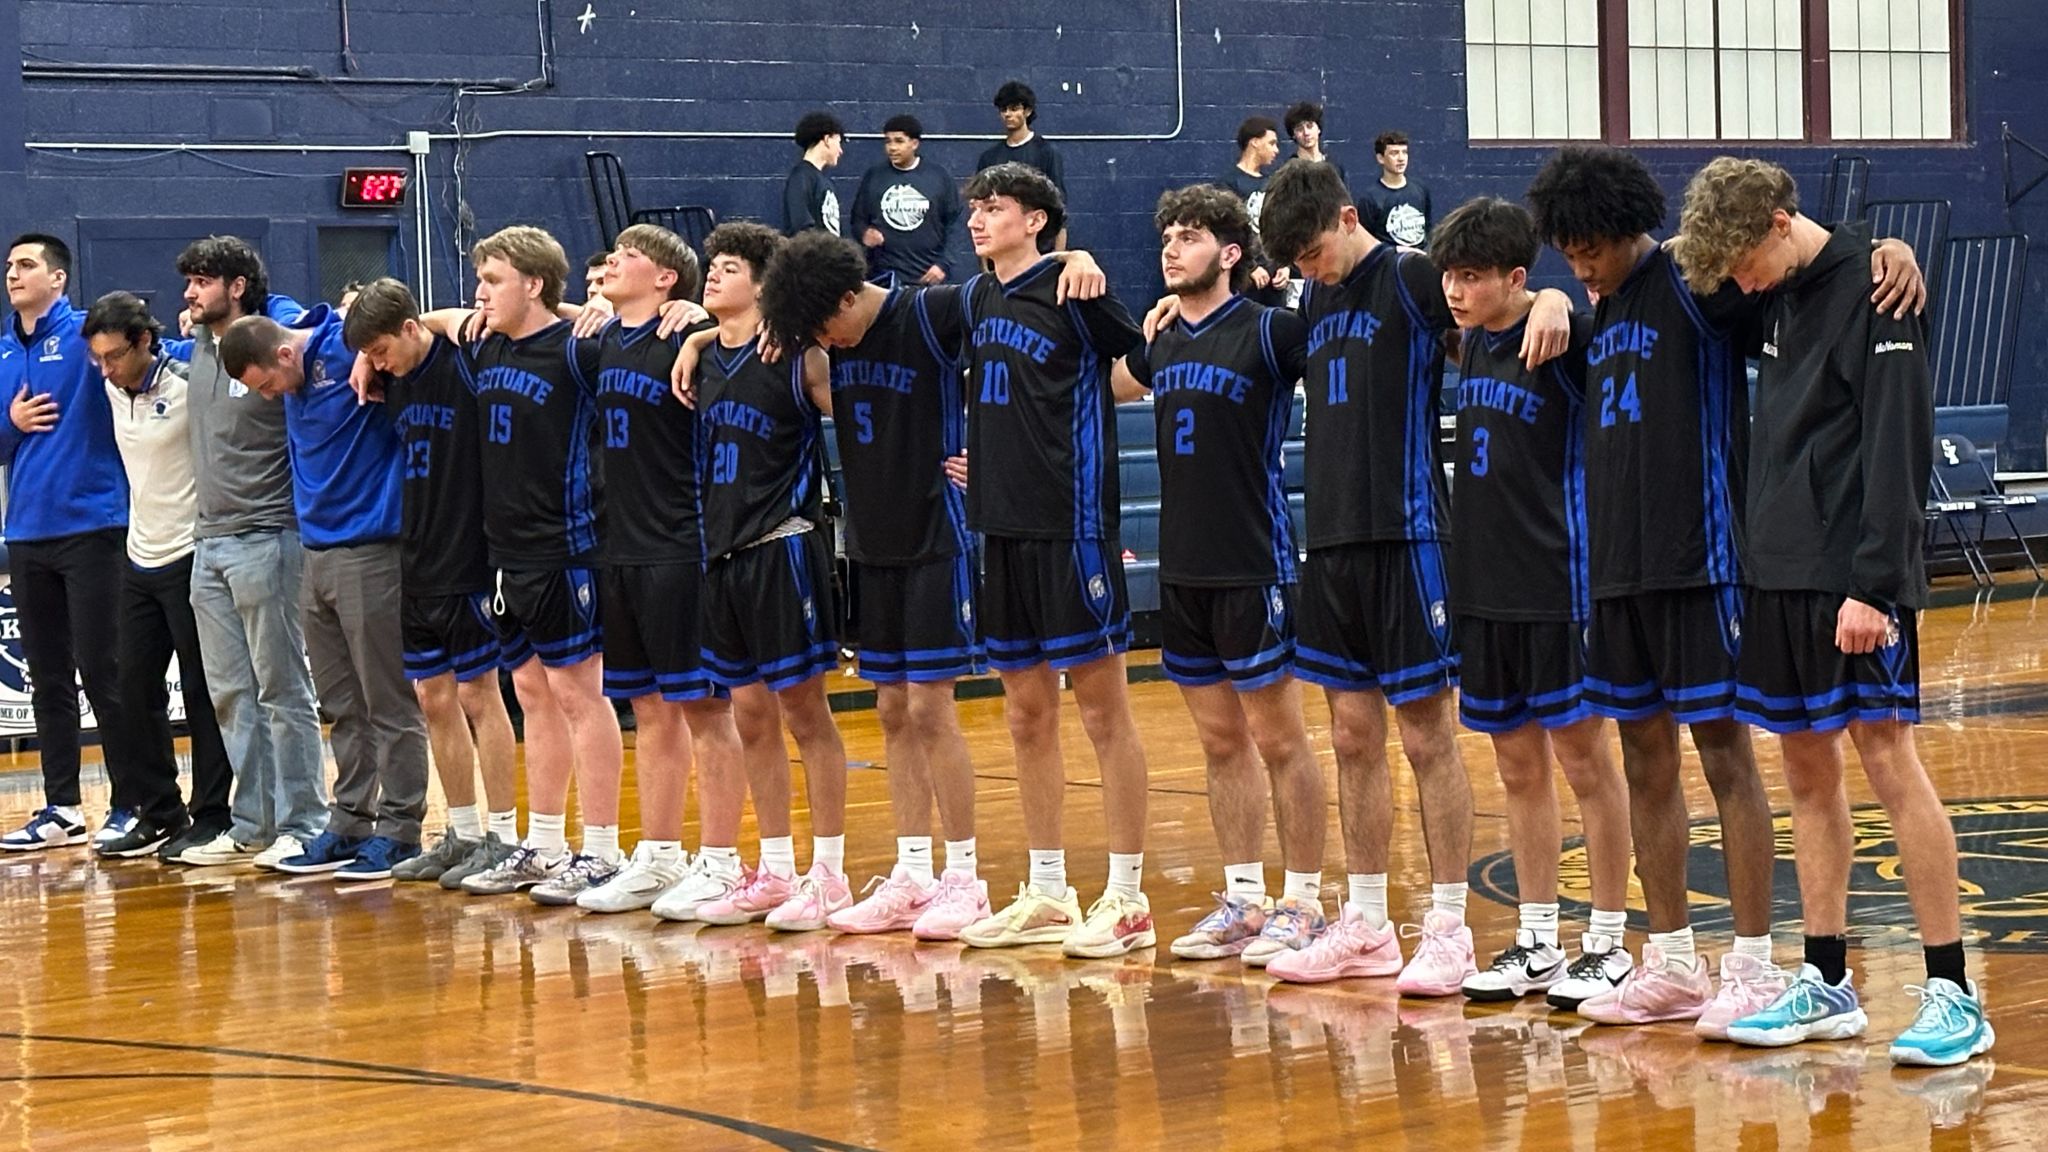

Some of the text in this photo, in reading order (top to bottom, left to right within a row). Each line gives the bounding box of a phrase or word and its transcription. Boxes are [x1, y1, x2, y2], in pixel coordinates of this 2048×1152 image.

[981, 360, 1009, 405] 10
[1152, 361, 1254, 405] CITUATE
[1328, 356, 1349, 405] 11
[1601, 371, 1641, 428] 24
[488, 404, 513, 445] 15
[605, 408, 630, 448] 13
[854, 402, 875, 444] 5
[1175, 408, 1195, 456] 2
[405, 440, 431, 480] 23
[713, 442, 739, 484] 20
[1471, 427, 1490, 477] 3
[16, 708, 29, 719] OF
